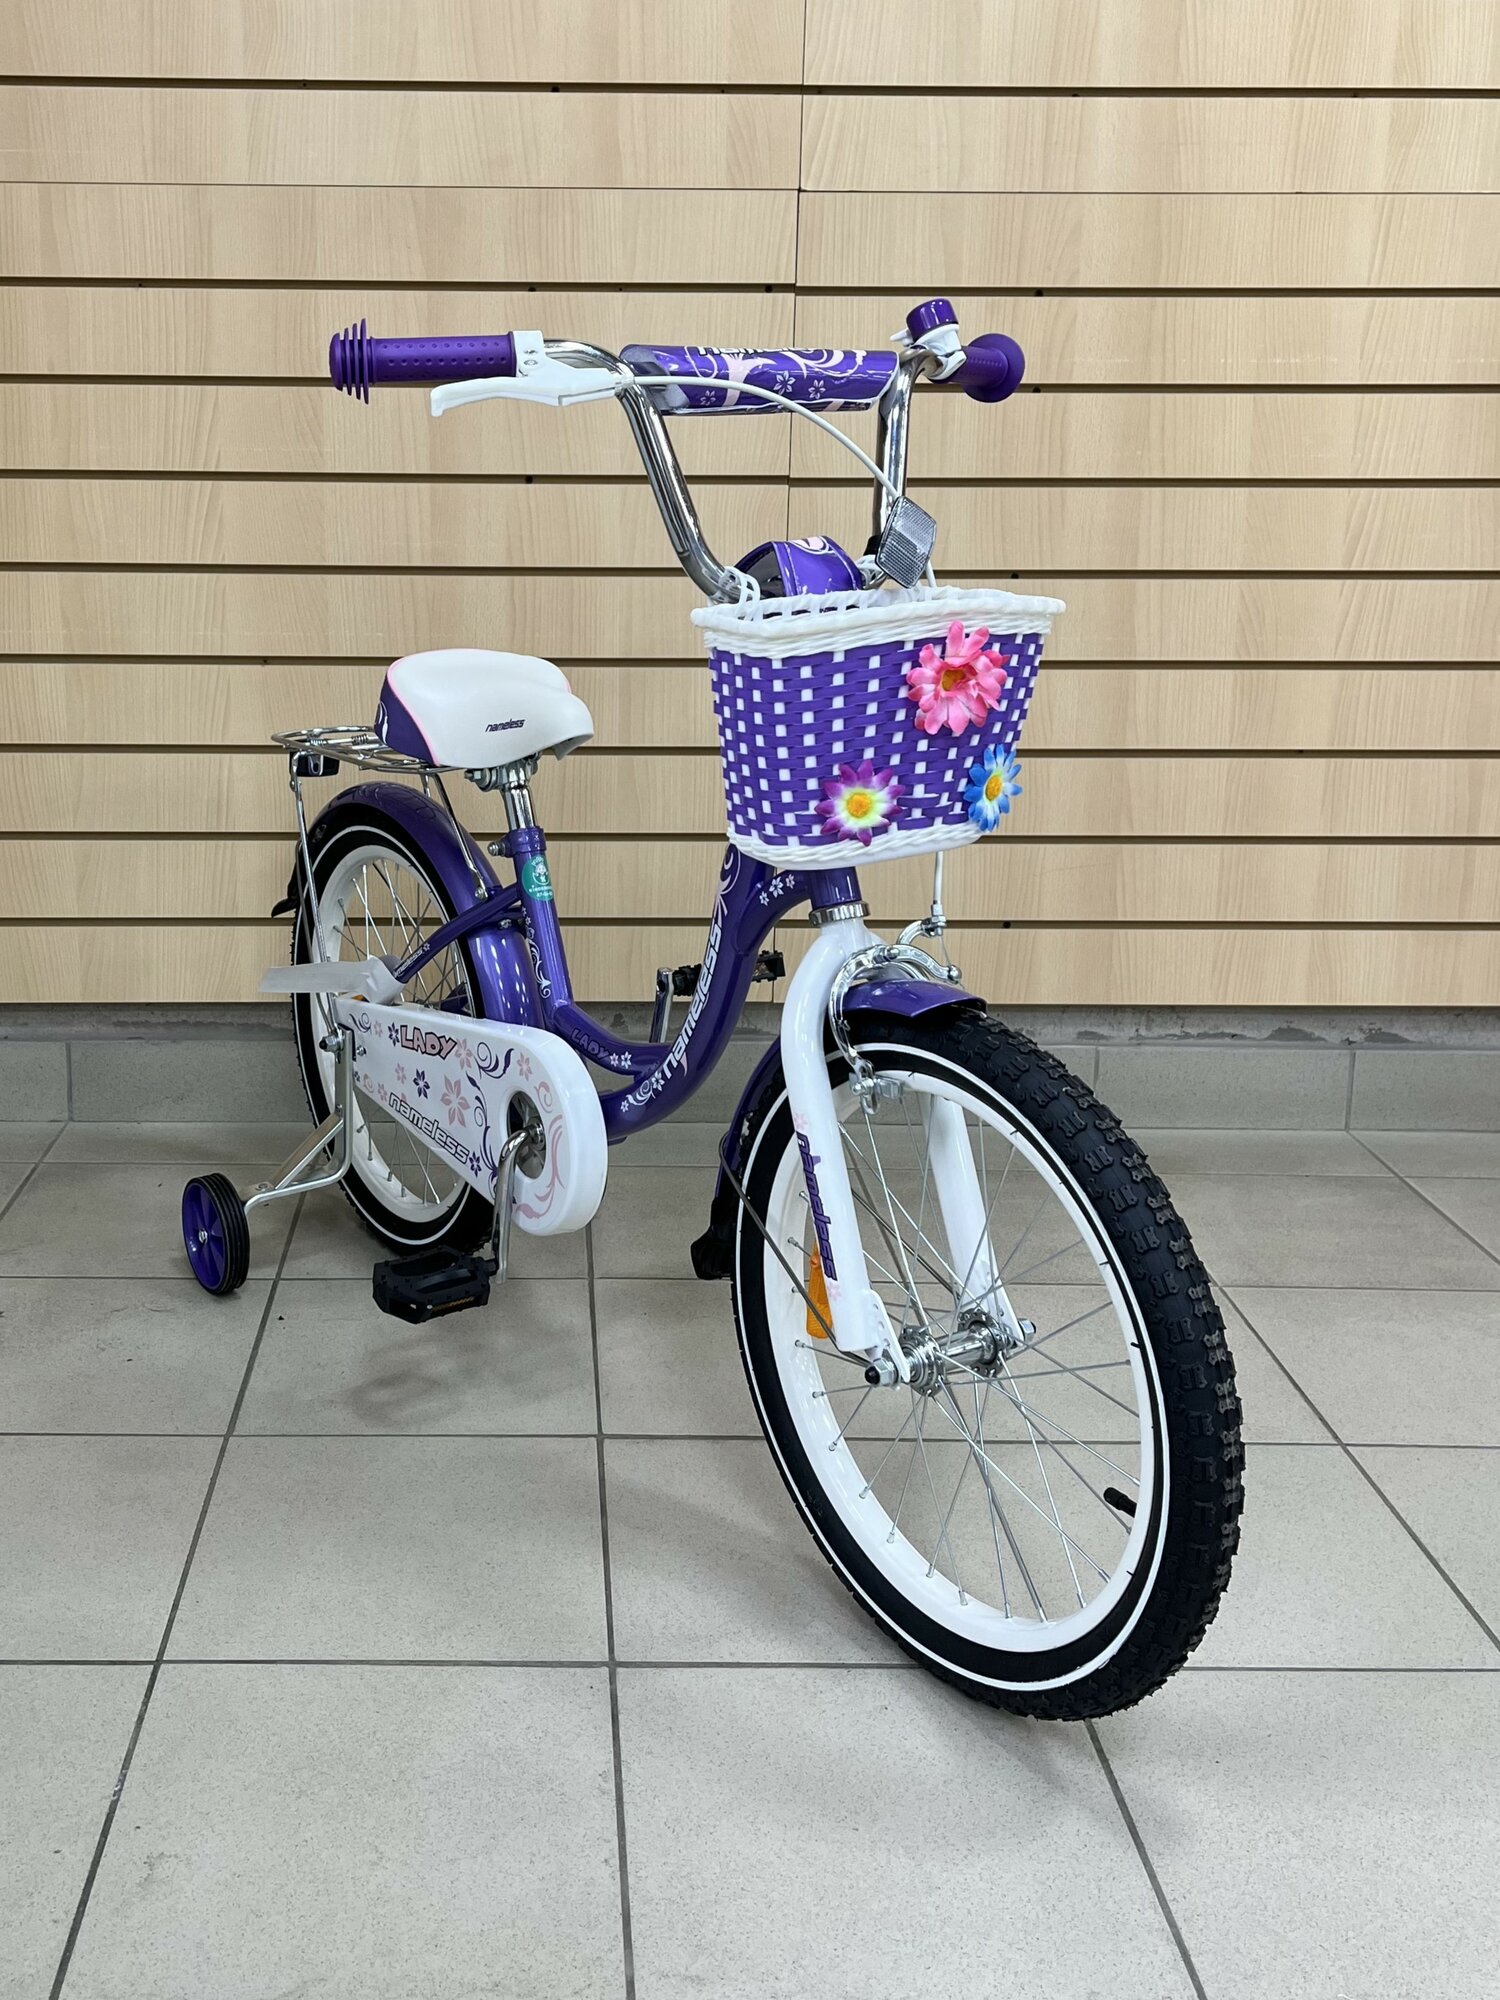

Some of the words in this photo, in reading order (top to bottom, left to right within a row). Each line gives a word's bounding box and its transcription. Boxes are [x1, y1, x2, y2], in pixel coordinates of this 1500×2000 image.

[485, 718, 525, 732] nameless
[664, 923, 722, 1079] nameless
[400, 1025, 457, 1060] LADY
[571, 1028, 609, 1060] LADY
[388, 1092, 470, 1165] nameless
[796, 1131, 837, 1281] nameless
